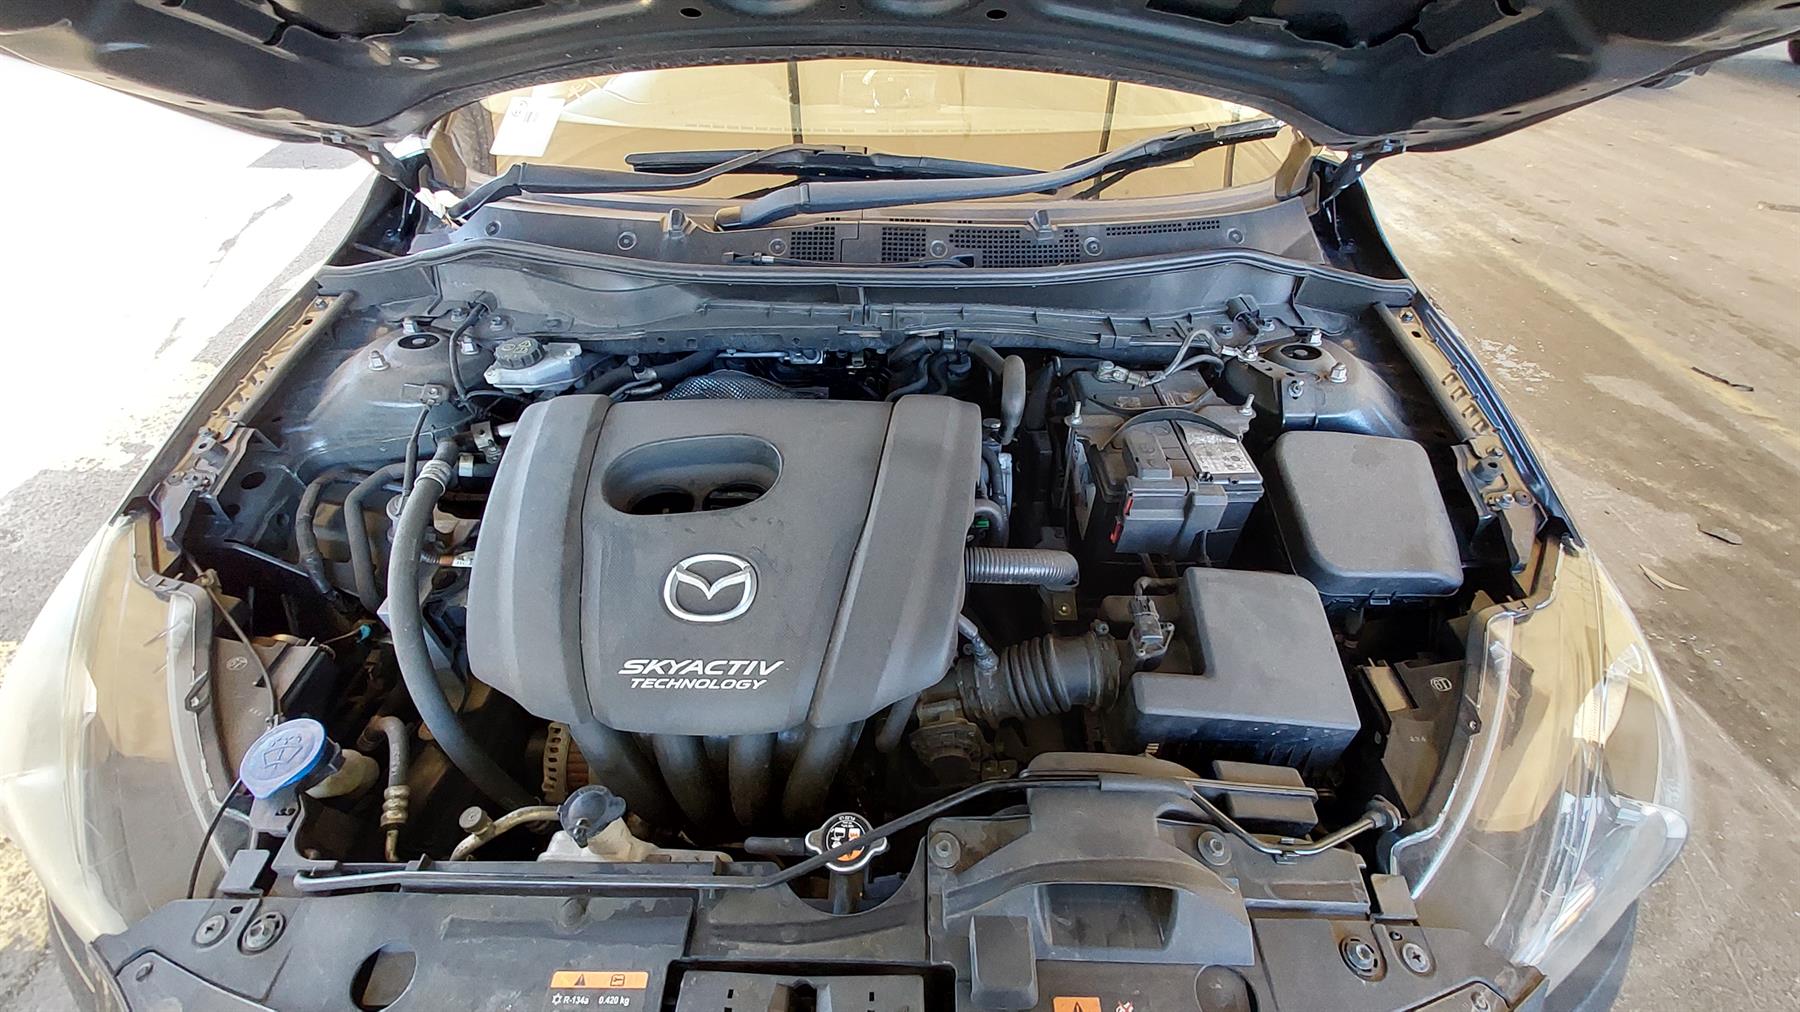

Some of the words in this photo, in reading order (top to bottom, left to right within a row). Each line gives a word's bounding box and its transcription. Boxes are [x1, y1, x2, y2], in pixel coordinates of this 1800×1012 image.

[618, 659, 784, 676] SKYACTIV
[631, 678, 767, 690] TECHNOLOGY
[563, 995, 589, 1005] R-134a
[598, 995, 619, 1005] 0.420
[620, 995, 630, 1007] kg
